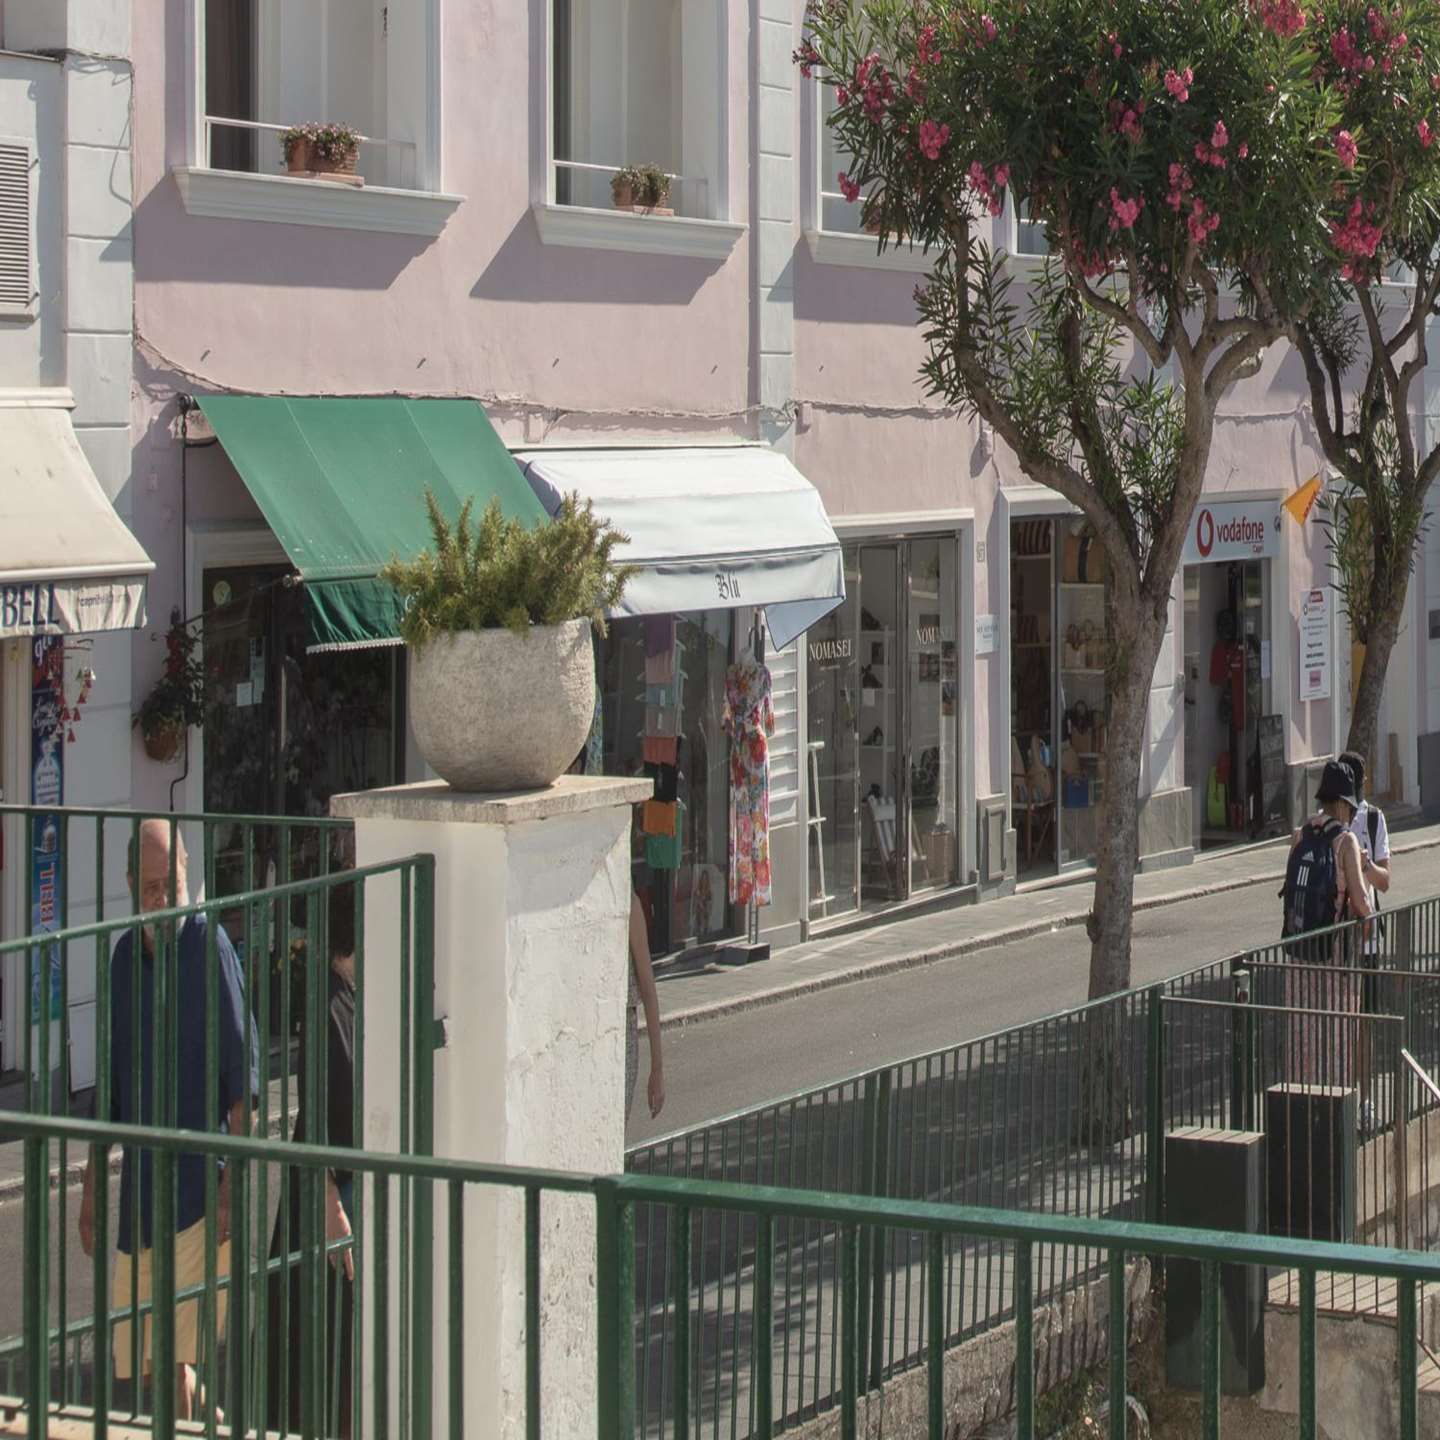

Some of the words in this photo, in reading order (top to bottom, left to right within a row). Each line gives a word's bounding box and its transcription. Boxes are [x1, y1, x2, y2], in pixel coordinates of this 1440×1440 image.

[1216, 516, 1264, 543] vodafone
[1, 583, 60, 628] BELL
[808, 639, 851, 661] NOMASEI
